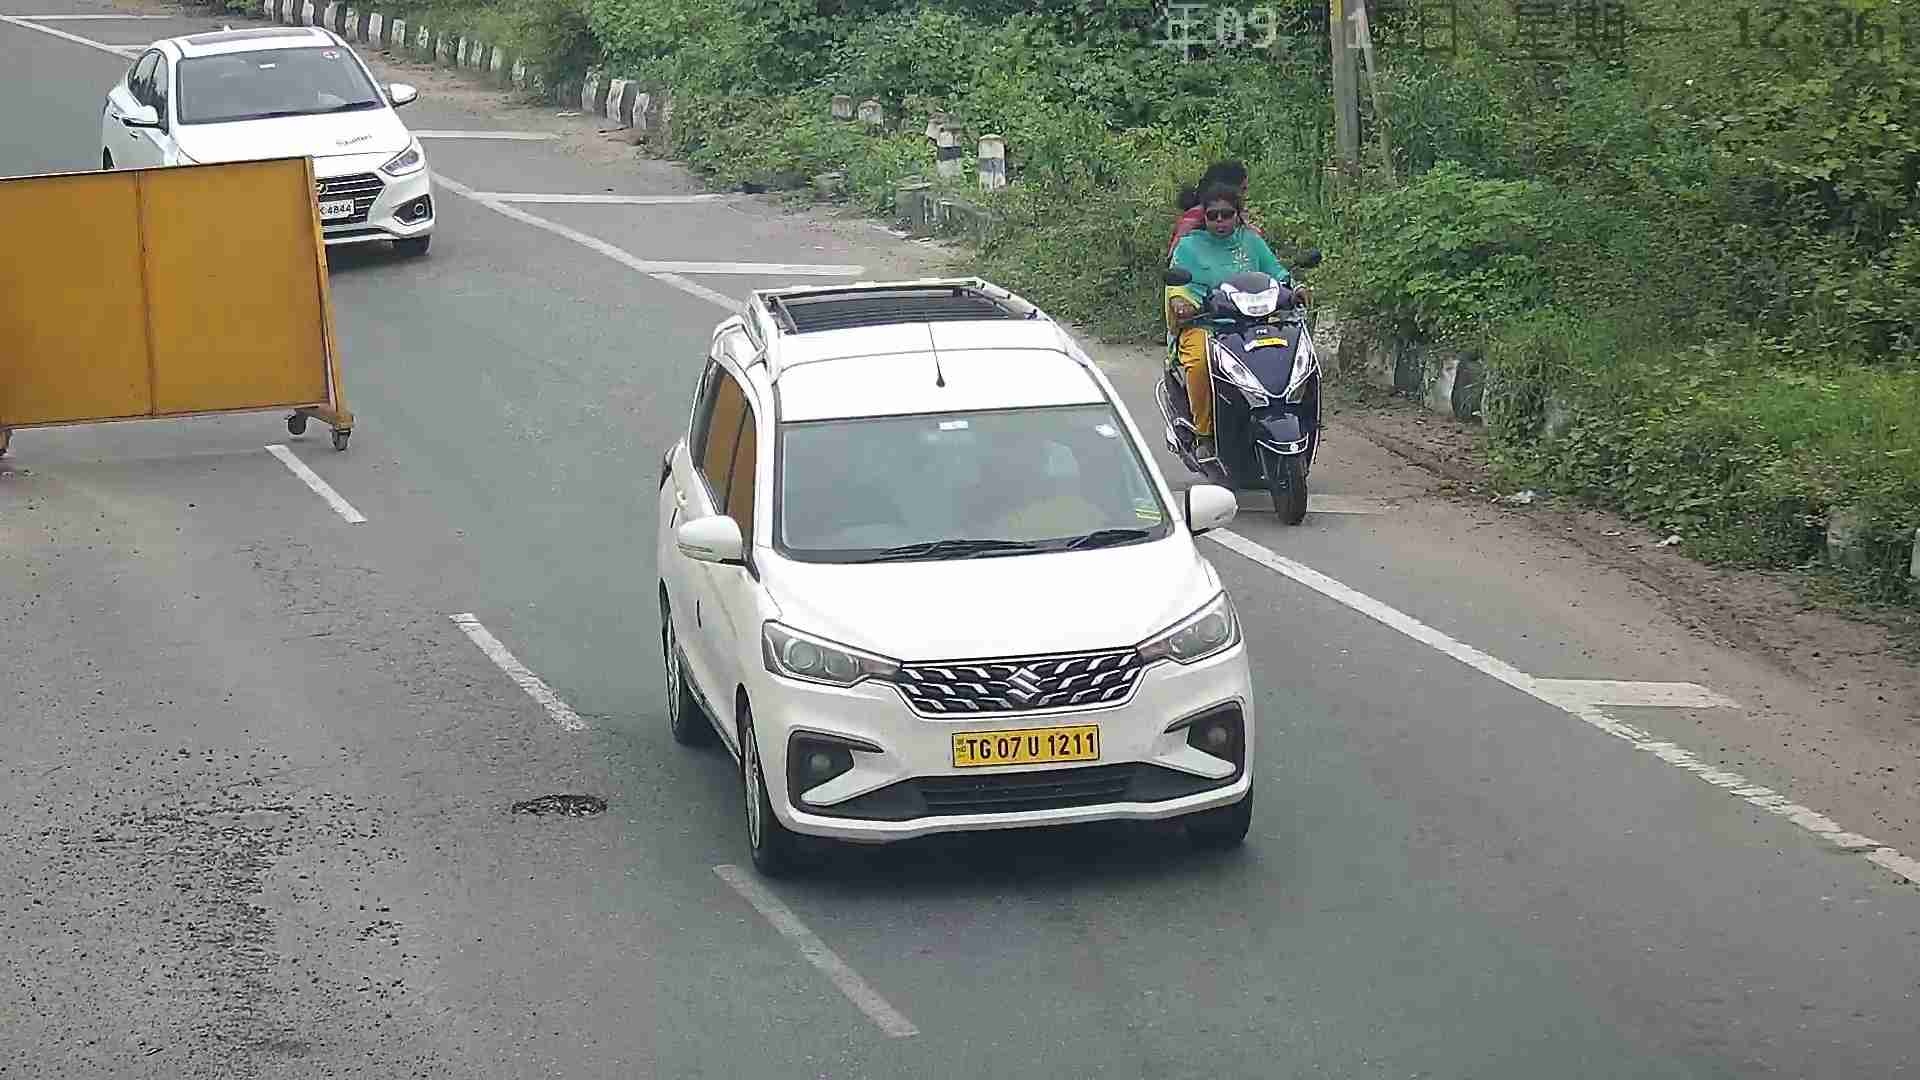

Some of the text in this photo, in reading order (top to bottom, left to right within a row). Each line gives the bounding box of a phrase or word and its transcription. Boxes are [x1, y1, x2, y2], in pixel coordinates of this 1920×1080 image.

[966, 739, 991, 760] TG
[997, 737, 1021, 759] 07
[1028, 736, 1039, 757] U
[1048, 732, 1094, 756] 1211
